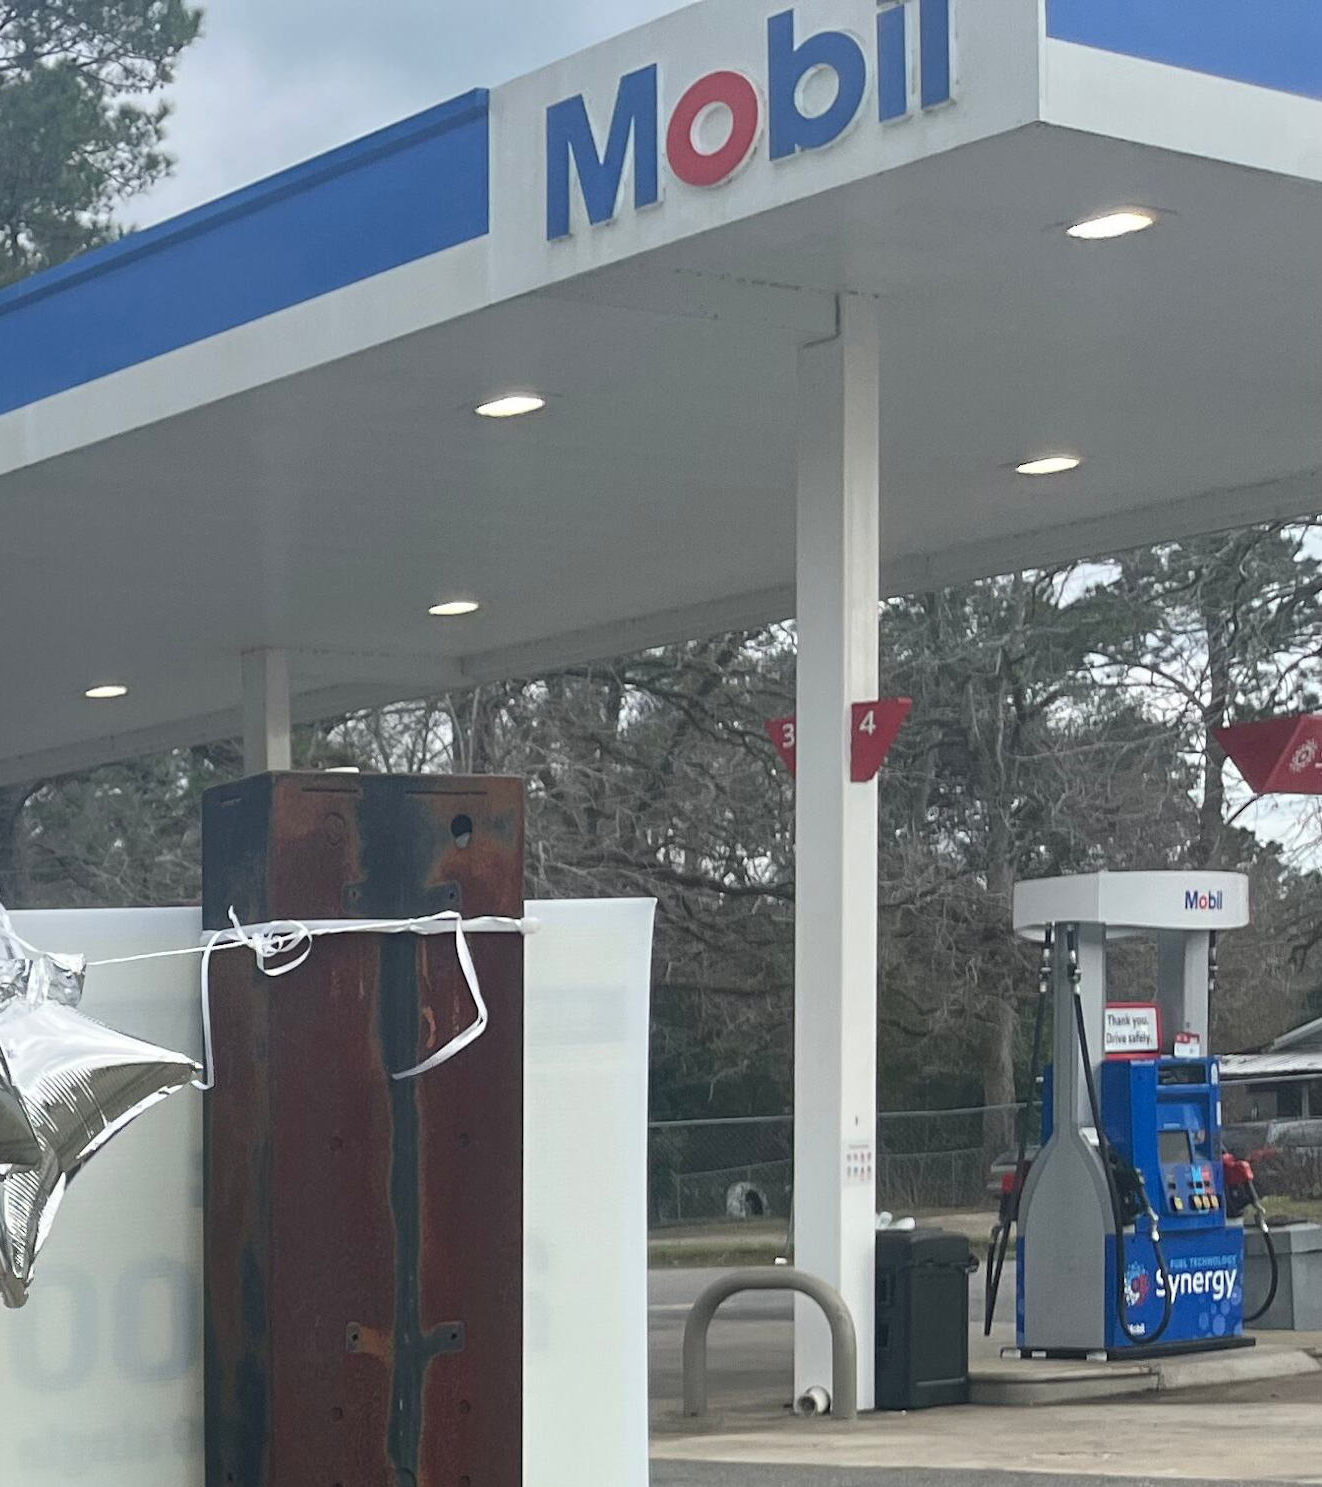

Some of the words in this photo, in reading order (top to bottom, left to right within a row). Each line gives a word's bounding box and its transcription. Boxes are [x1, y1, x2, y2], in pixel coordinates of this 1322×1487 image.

[546, 0, 949, 241] Mobil
[859, 710, 876, 735] 4
[782, 723, 795, 748] 3
[1185, 890, 1222, 910] Mobil
[1107, 1014, 1131, 1025] Thank
[1106, 1032, 1126, 1043] Drive
[1170, 1259, 1187, 1269] FUEL
[1190, 1254, 1237, 1267] TECHNOLOGY
[1156, 1268, 1237, 1304] Synergy
